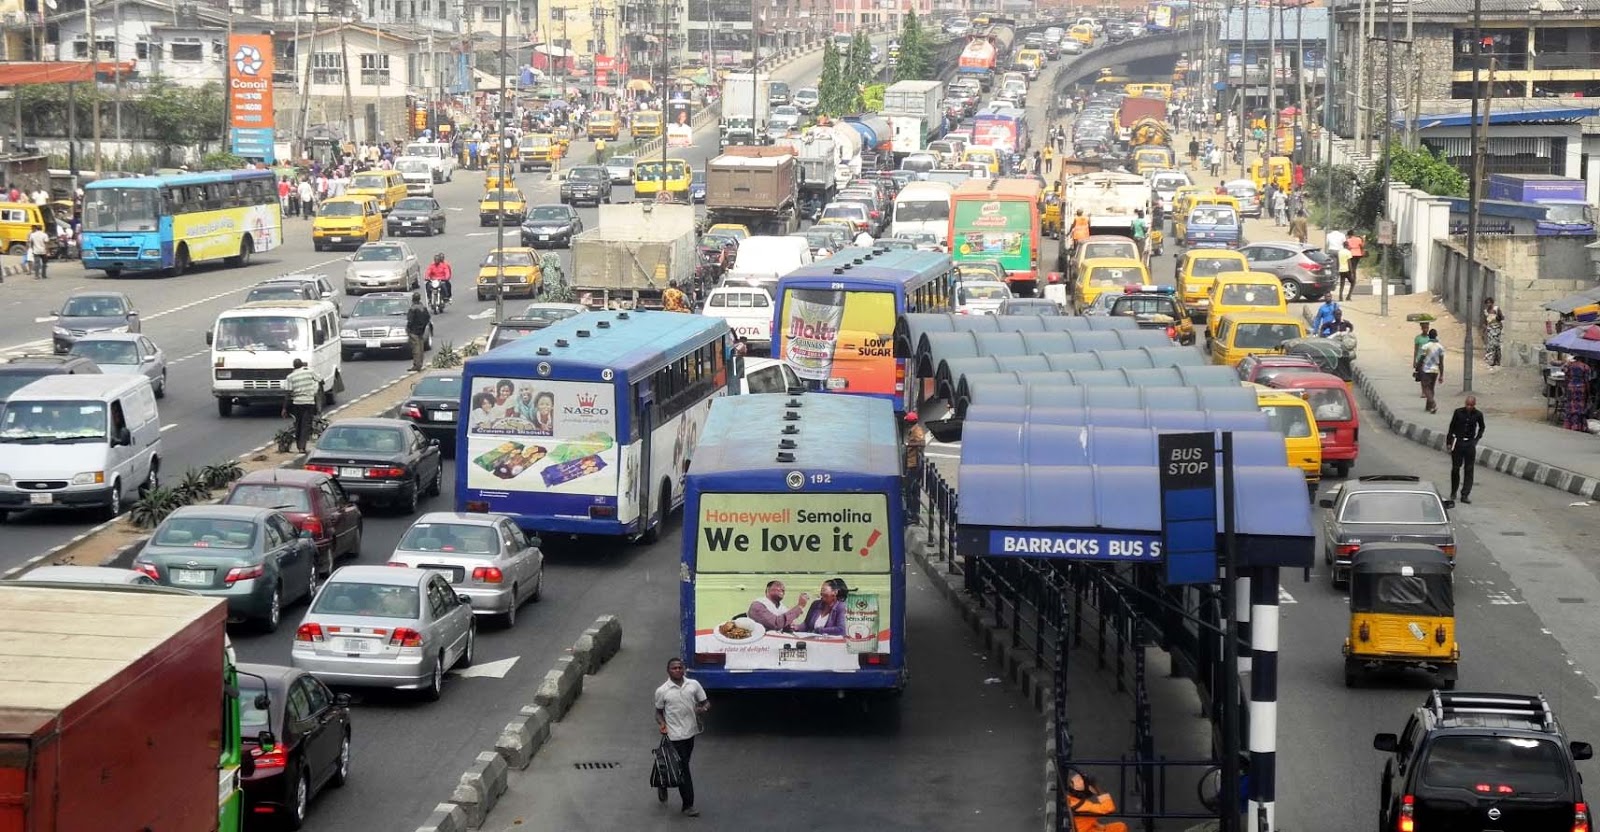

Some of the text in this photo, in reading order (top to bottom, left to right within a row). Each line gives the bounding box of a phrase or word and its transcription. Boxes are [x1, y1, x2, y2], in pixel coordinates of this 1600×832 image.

[231, 79, 268, 89] Conoil
[864, 338, 886, 348] LOW
[858, 348, 891, 357] SUGAR
[563, 406, 609, 416] NASCO
[1171, 447, 1203, 461] BUS
[1168, 461, 1209, 476] STOP
[810, 474, 831, 484] 192
[706, 509, 872, 526] Honeywell Semolina
[704, 527, 750, 552] We
[761, 528, 821, 552] love
[1004, 536, 1163, 557] BARRACKS BUS S
